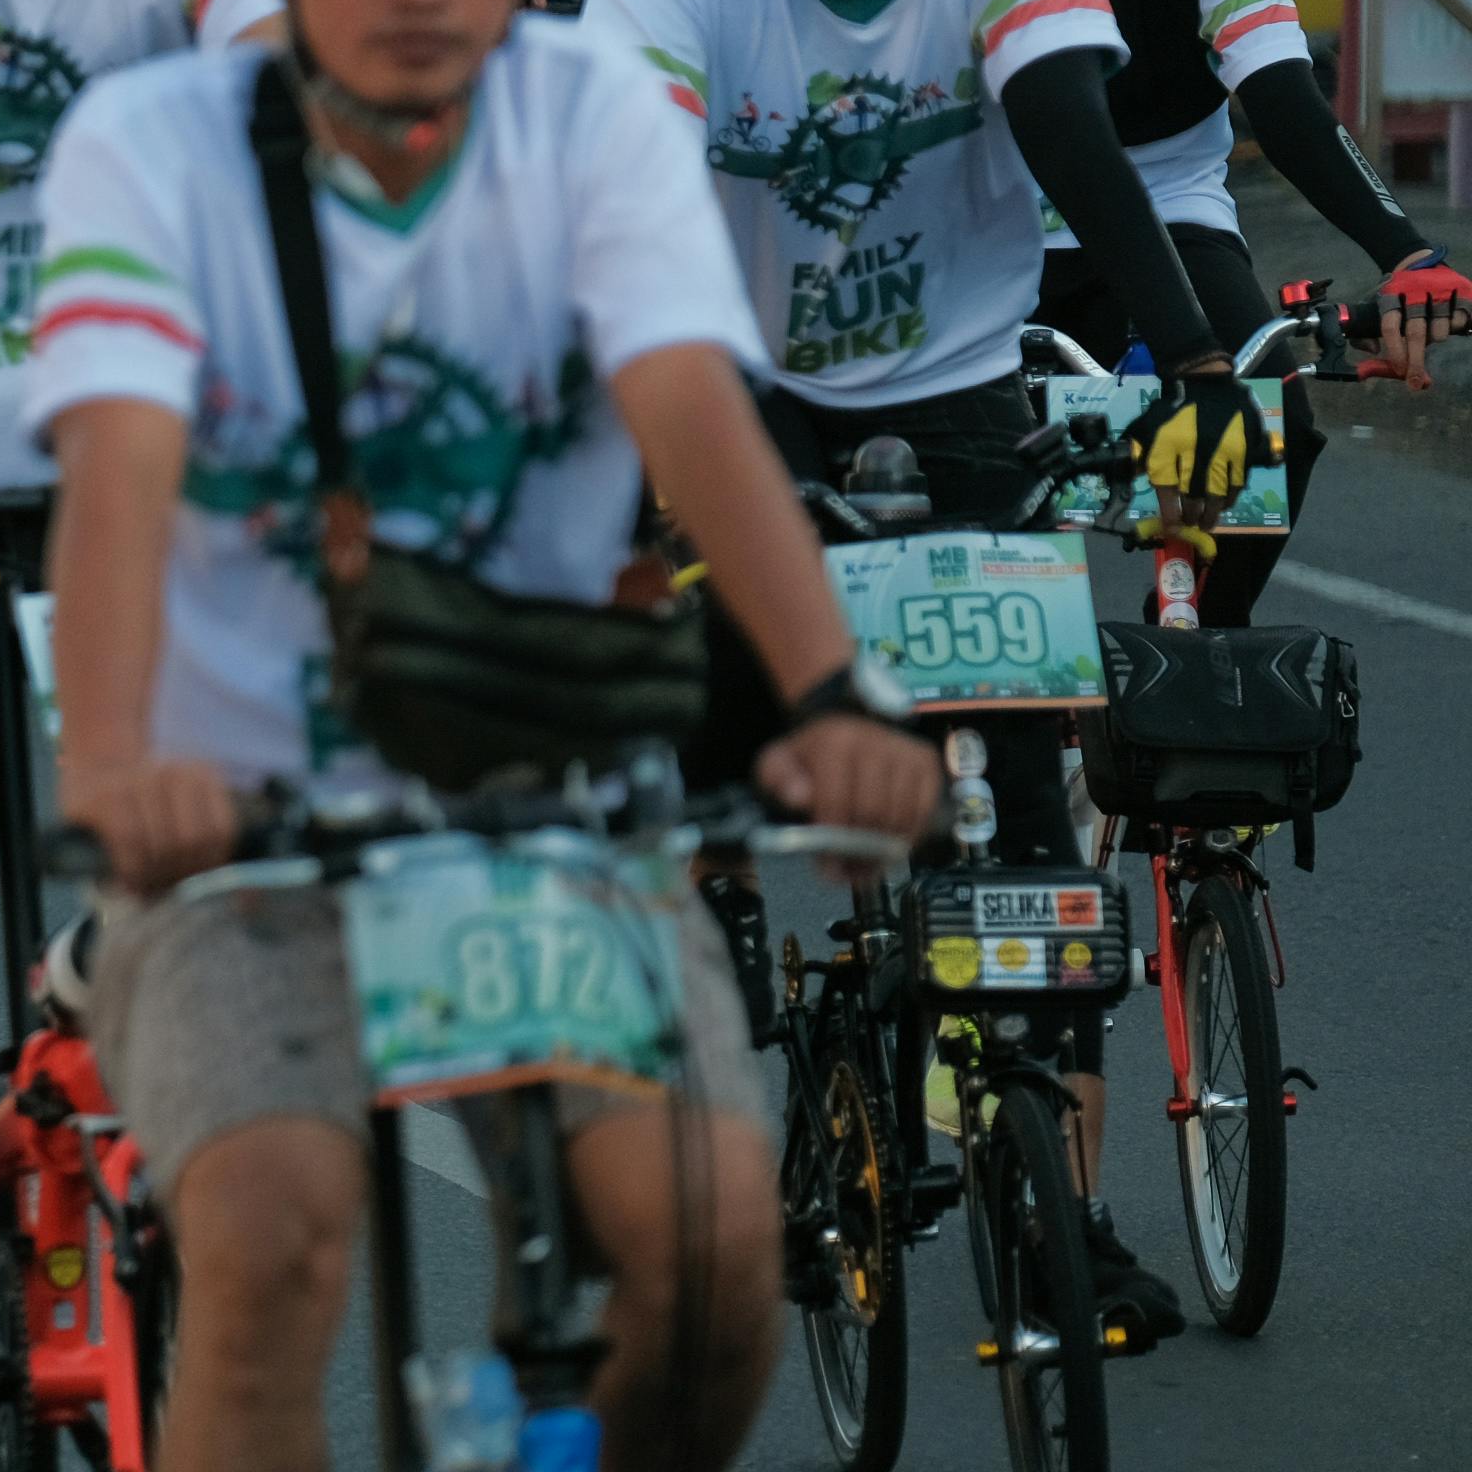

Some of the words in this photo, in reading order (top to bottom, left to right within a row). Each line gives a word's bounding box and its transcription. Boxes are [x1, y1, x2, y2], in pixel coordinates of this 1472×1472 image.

[788, 262, 924, 336] FUN
[785, 305, 928, 374] BIKE
[929, 546, 968, 566] MB
[900, 591, 1049, 670] 559
[983, 891, 1054, 921] SELIKA
